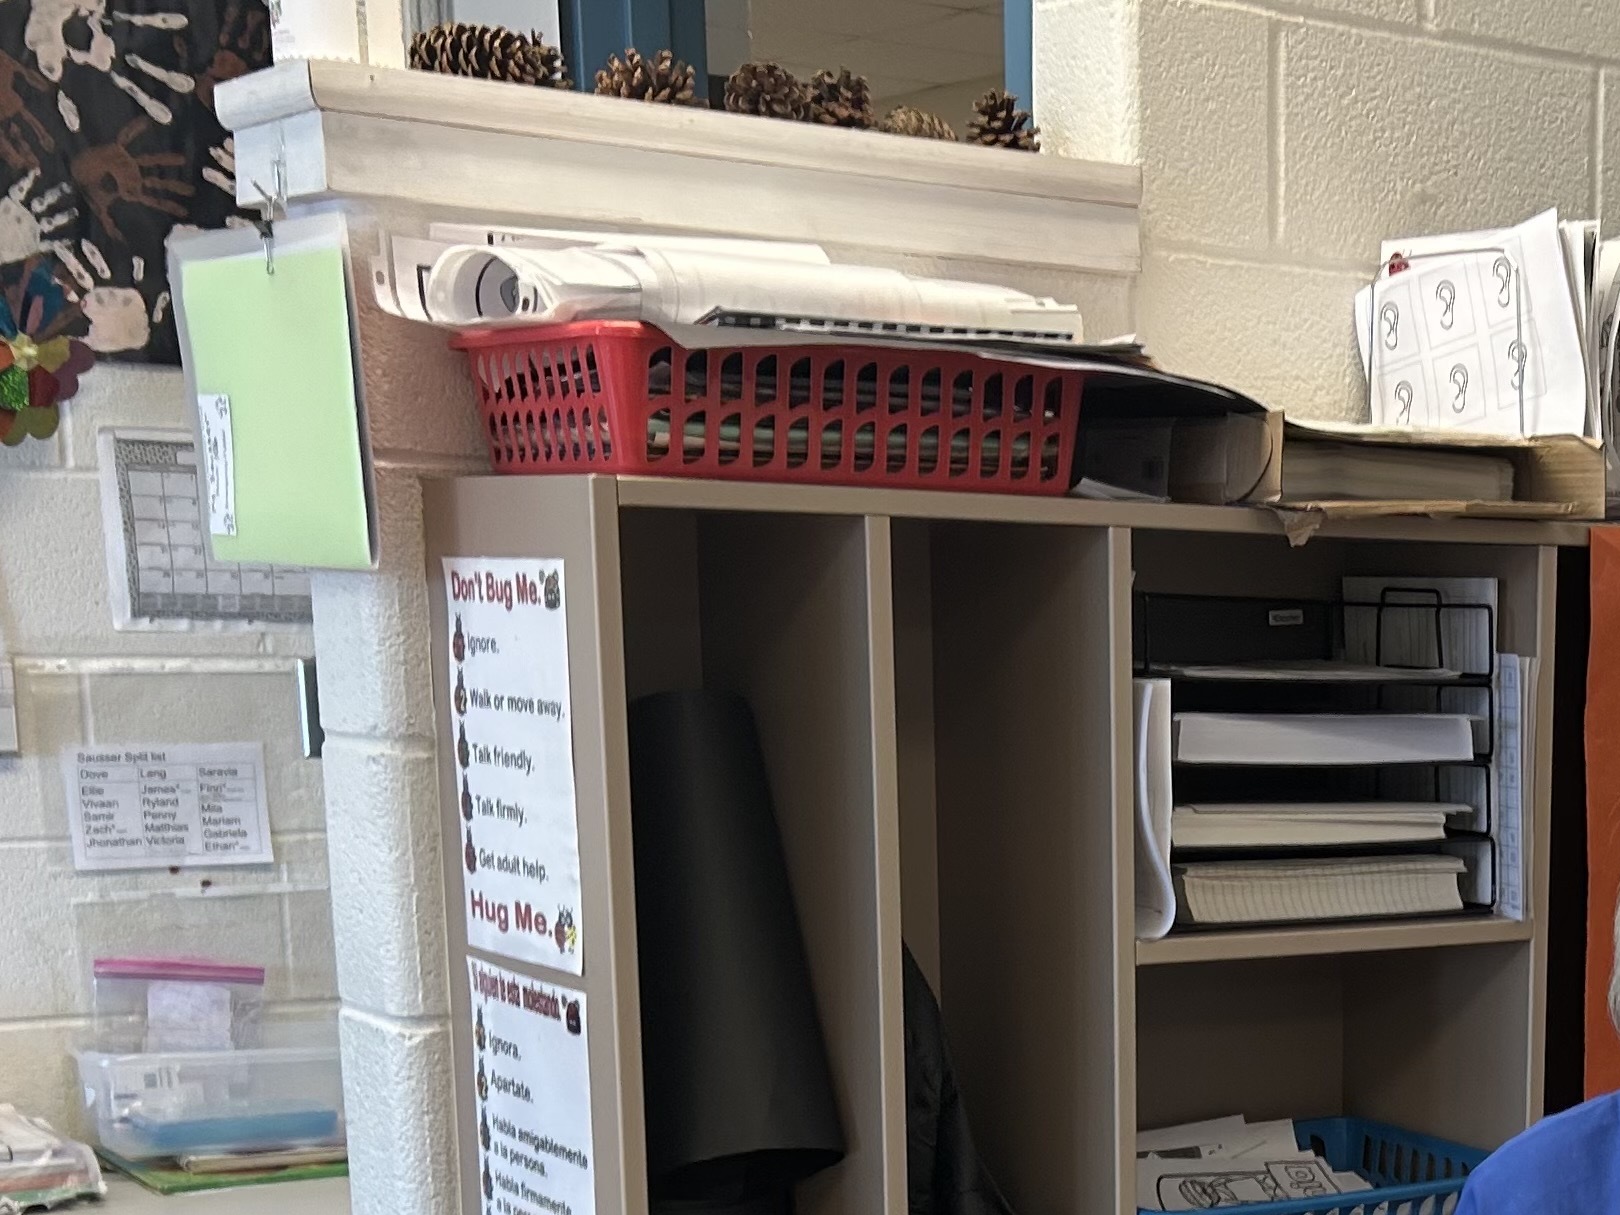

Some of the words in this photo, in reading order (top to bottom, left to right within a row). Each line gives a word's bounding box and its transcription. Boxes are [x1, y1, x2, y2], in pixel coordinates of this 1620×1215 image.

[451, 570, 484, 604] Don't
[486, 570, 513, 612] Bug
[516, 571, 541, 606] Me.
[467, 633, 500, 657] Ignore.
[470, 689, 492, 710] Walk
[494, 694, 505, 710] or
[507, 695, 535, 714] move
[537, 699, 566, 722] away.
[473, 743, 491, 764] Talk
[494, 746, 535, 776] friendly.
[475, 794, 494, 817] Talk
[496, 799, 528, 828] firmly.
[479, 848, 496, 870] Get
[497, 851, 521, 877] adult
[522, 856, 549, 884] help.
[470, 888, 509, 934] Hug
[514, 899, 553, 938] Me.
[489, 1031, 522, 1062] Ignora.
